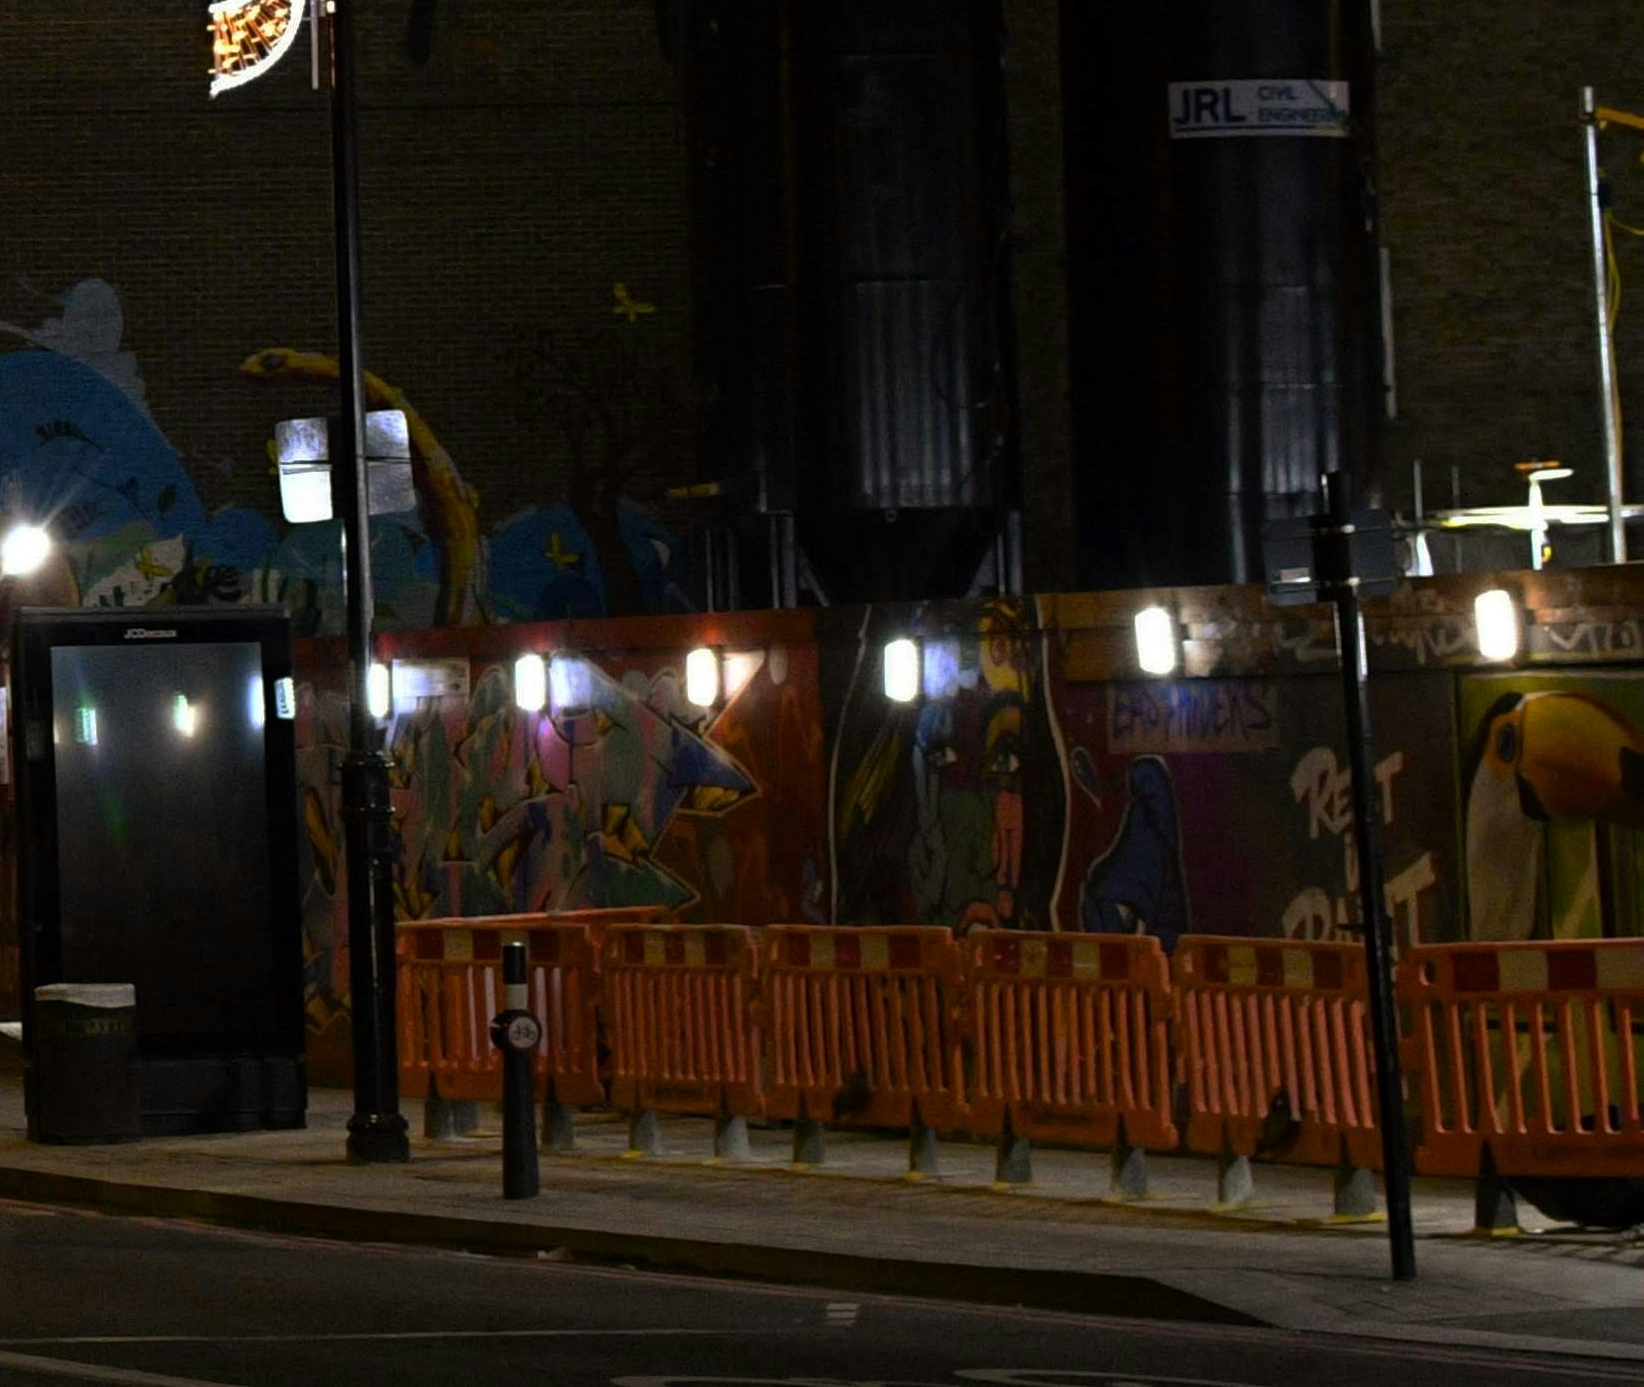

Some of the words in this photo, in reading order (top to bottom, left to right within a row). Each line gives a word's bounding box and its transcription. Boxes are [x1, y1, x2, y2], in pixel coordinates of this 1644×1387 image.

[1173, 87, 1246, 125] JRL
[1257, 85, 1298, 101] CIVIL
[1288, 746, 1404, 841] RET
